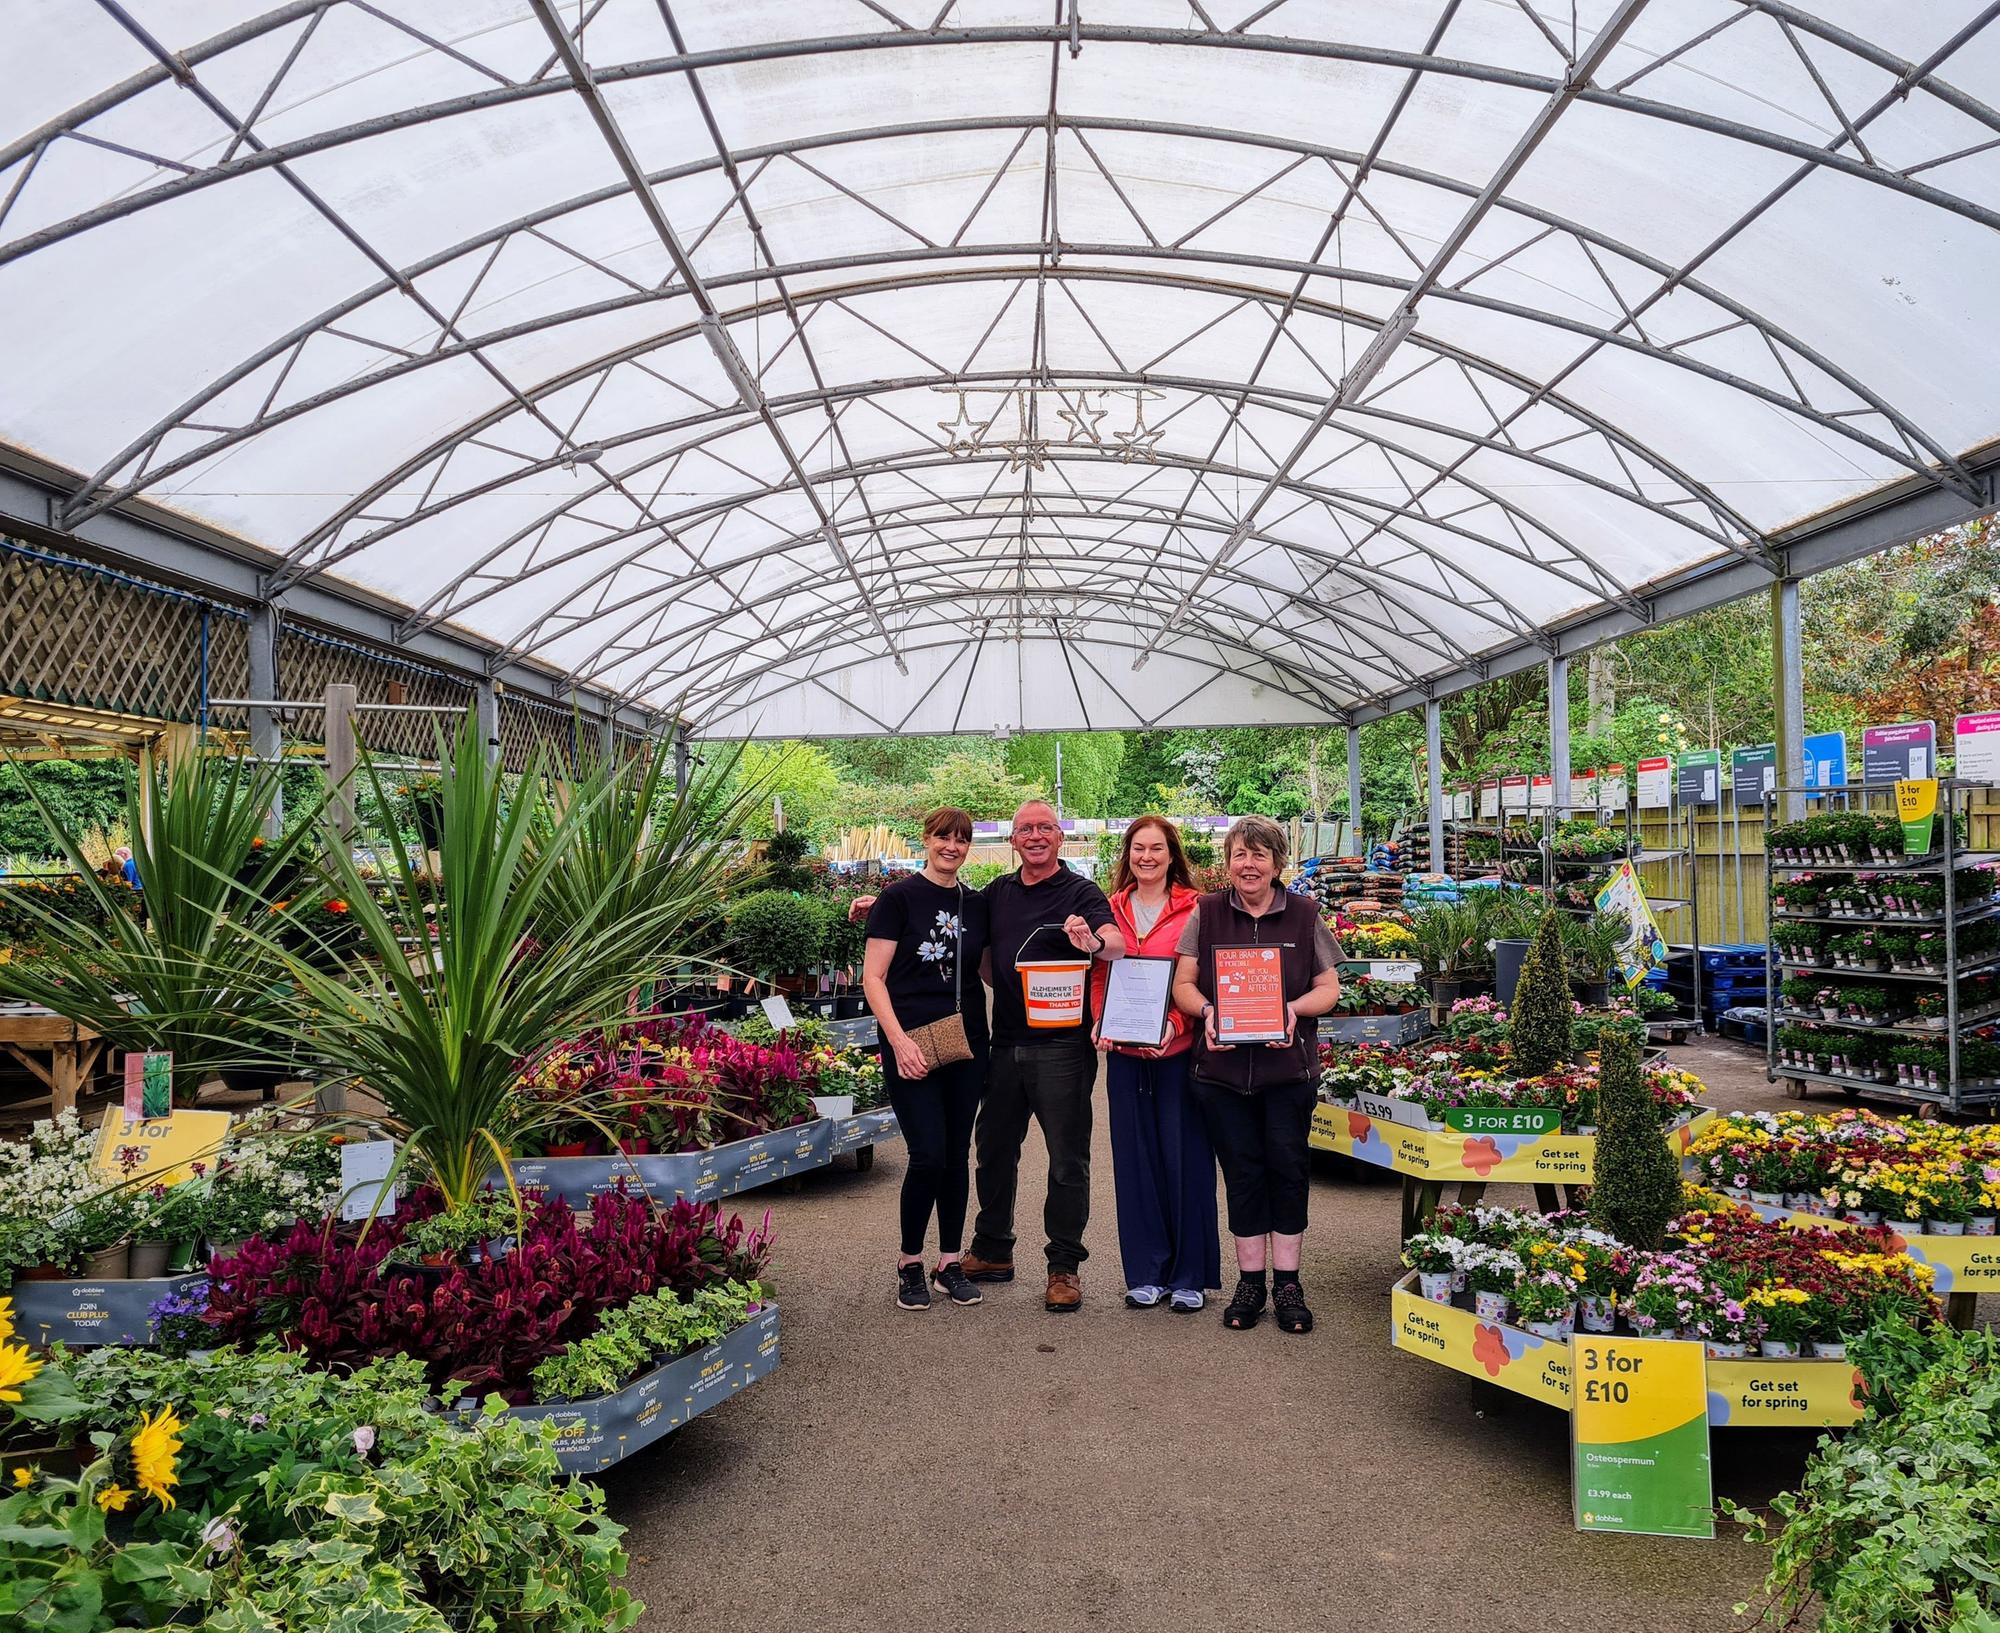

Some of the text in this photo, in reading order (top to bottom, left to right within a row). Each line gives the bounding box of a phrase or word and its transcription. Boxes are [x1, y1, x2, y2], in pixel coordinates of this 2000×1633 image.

[1900, 785, 1920, 795] 3 for
[1902, 797, 1917, 806] £10
[1217, 951, 1258, 960] YOUR BRAIN
[1248, 975, 1279, 984] LOOKING
[1248, 984, 1267, 992] AFTER
[1364, 1101, 1392, 1120] £3.99
[1312, 1114, 1333, 1127] Get set
[1463, 1114, 1544, 1129] 3 FOR £10
[120, 1121, 172, 1138] 3 for
[1318, 1127, 1336, 1140] spring
[112, 1144, 151, 1163] £5
[1402, 1140, 1425, 1154] Get set
[1398, 1150, 1430, 1169] for spring
[1542, 1150, 1580, 1158] Get set
[1535, 1160, 1586, 1172] for spring
[1971, 1253, 1992, 1263] Get
[1964, 1266, 1981, 1276] for
[66, 1311, 88, 1319] CLUB
[1408, 1312, 1439, 1331] Get set
[1403, 1323, 1445, 1350] for spring
[1585, 1349, 1643, 1373] 3 for
[1548, 1361, 1567, 1376] Get
[1542, 1374, 1556, 1388] for
[1750, 1380, 1799, 1392] Get set
[1586, 1380, 1629, 1403] £10
[1742, 1396, 1808, 1410] for spring
[640, 1413, 657, 1428] TODAY
[564, 1428, 585, 1437] OFF
[1586, 1453, 1655, 1466] Osteospermum
[1588, 1489, 1632, 1500] £3.99 each
[1595, 1515, 1623, 1523] dobbies
